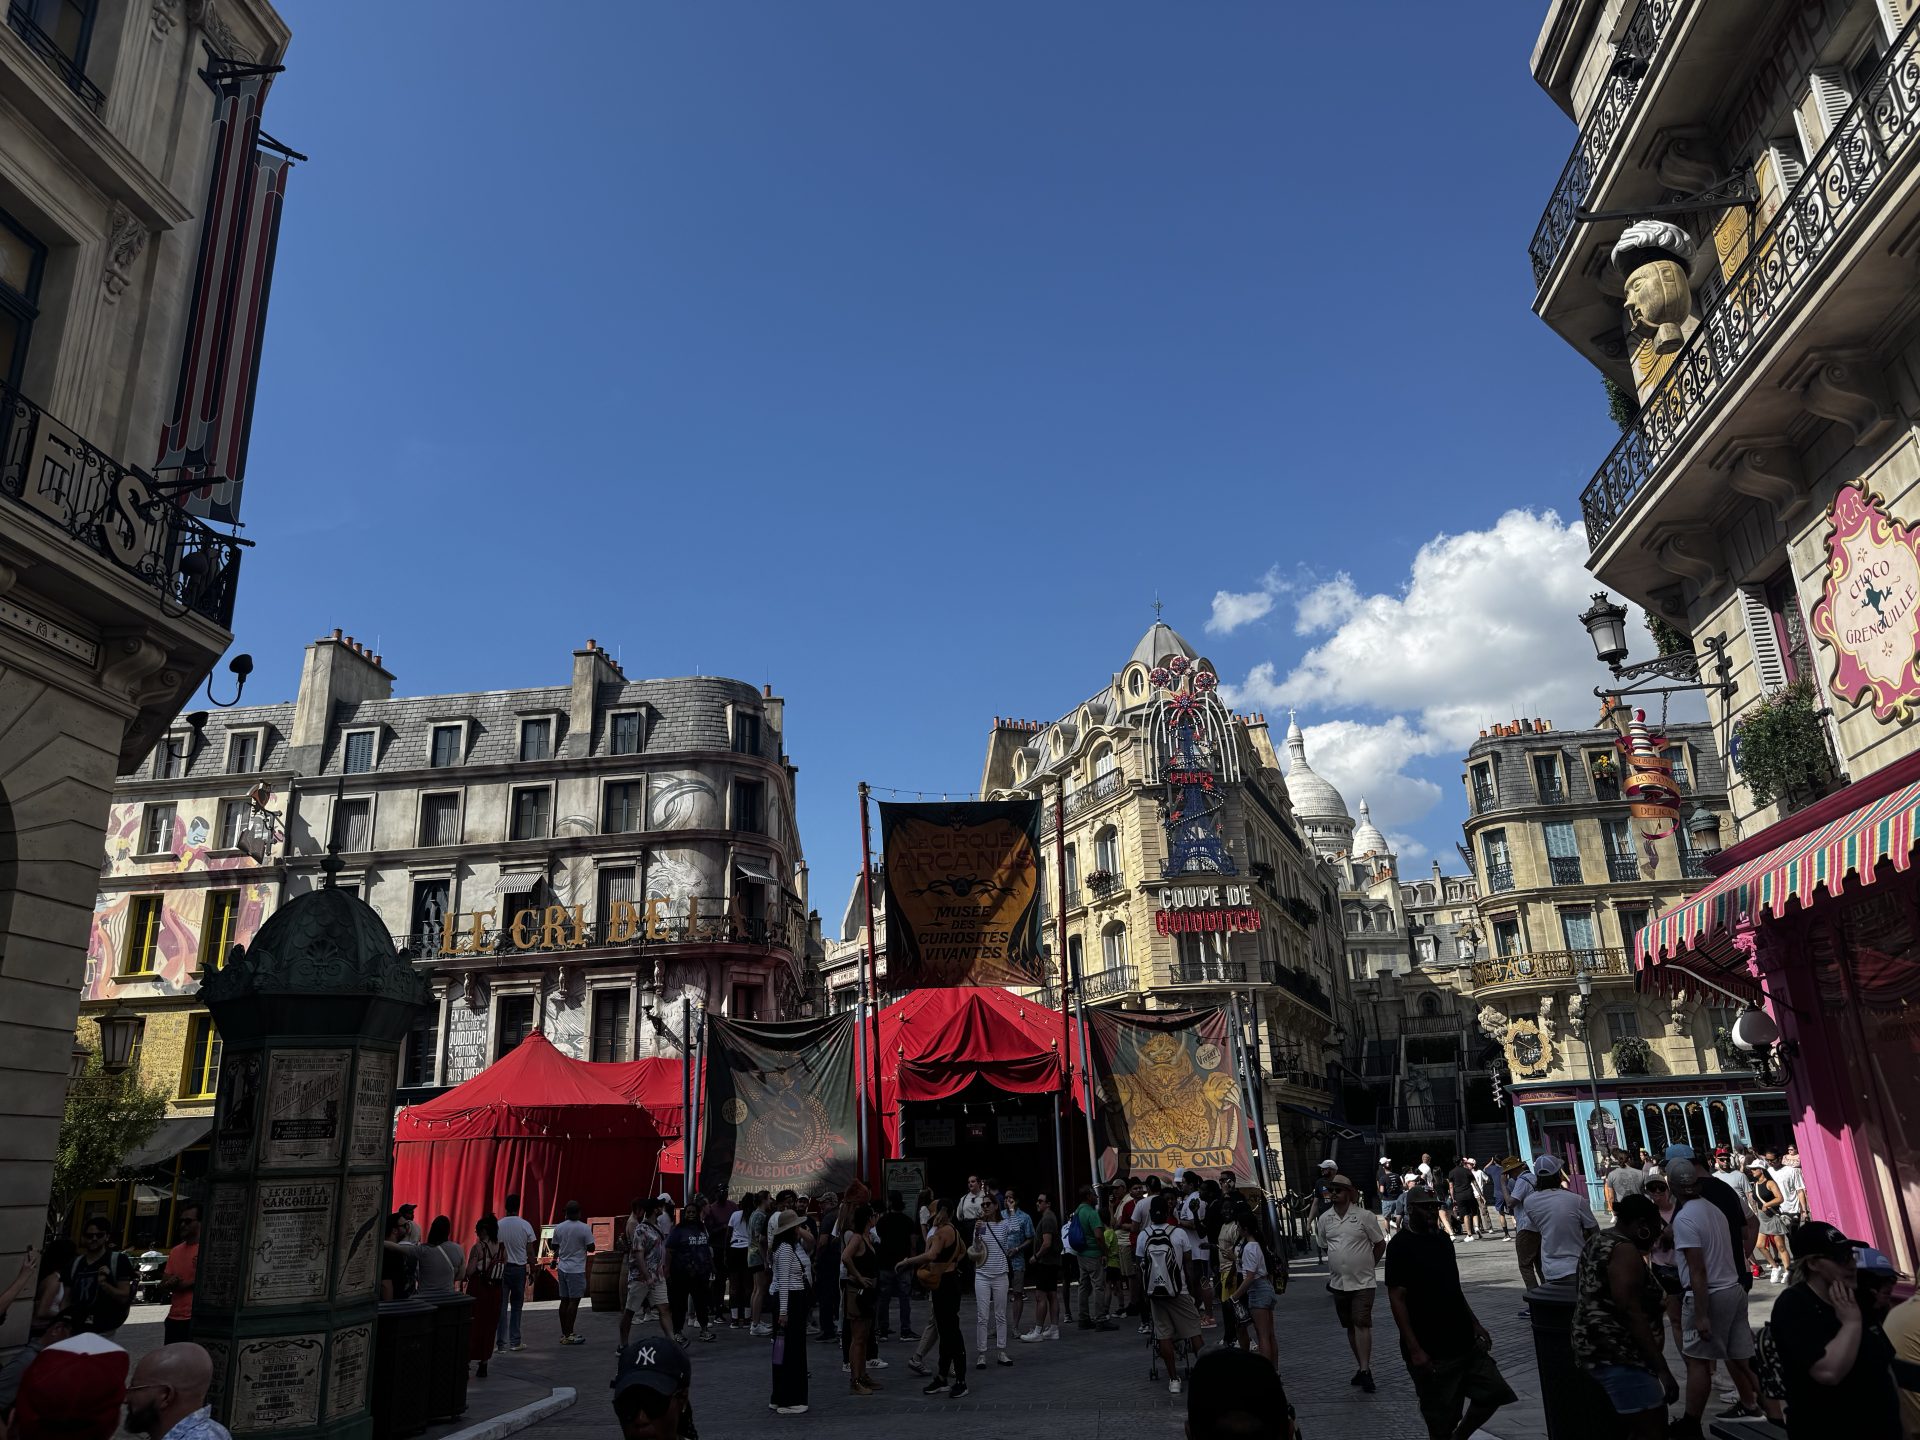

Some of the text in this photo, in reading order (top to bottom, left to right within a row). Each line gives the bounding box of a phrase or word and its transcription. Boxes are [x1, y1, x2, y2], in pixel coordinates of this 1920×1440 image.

[1849, 560, 1890, 600] CHOCO
[1846, 584, 1917, 645] GRENOUILLE
[1170, 771, 1214, 785] PARIS
[906, 832, 1016, 850] LE CIRQUE
[1158, 884, 1252, 909] COUPE DE
[935, 902, 992, 922] MUSÉE
[438, 906, 497, 957] LE
[508, 900, 592, 951] CRI
[605, 896, 671, 946] DE
[951, 919, 977, 930] DES
[1155, 909, 1261, 937] QUIDDITCH
[917, 929, 1010, 946] CURIOSITÉS
[925, 946, 1003, 963] VIVANTES
[451, 1009, 460, 1022] EN
[457, 1020, 480, 1031] NOUVELLES
[449, 1030, 487, 1049] QUIDDITCH
[454, 1045, 479, 1057] POTIONS
[454, 1056, 478, 1068] CULTURE
[448, 1068, 462, 1082] AITS
[1126, 1153, 1161, 1169] ONI
[1167, 1150, 1185, 1168] 鬼
[1191, 1150, 1228, 1167] ONI
[269, 1186, 326, 1198] LE CRI DE LA
[262, 1195, 330, 1208] GARGOUILLE
[635, 1346, 657, 1366] NY
